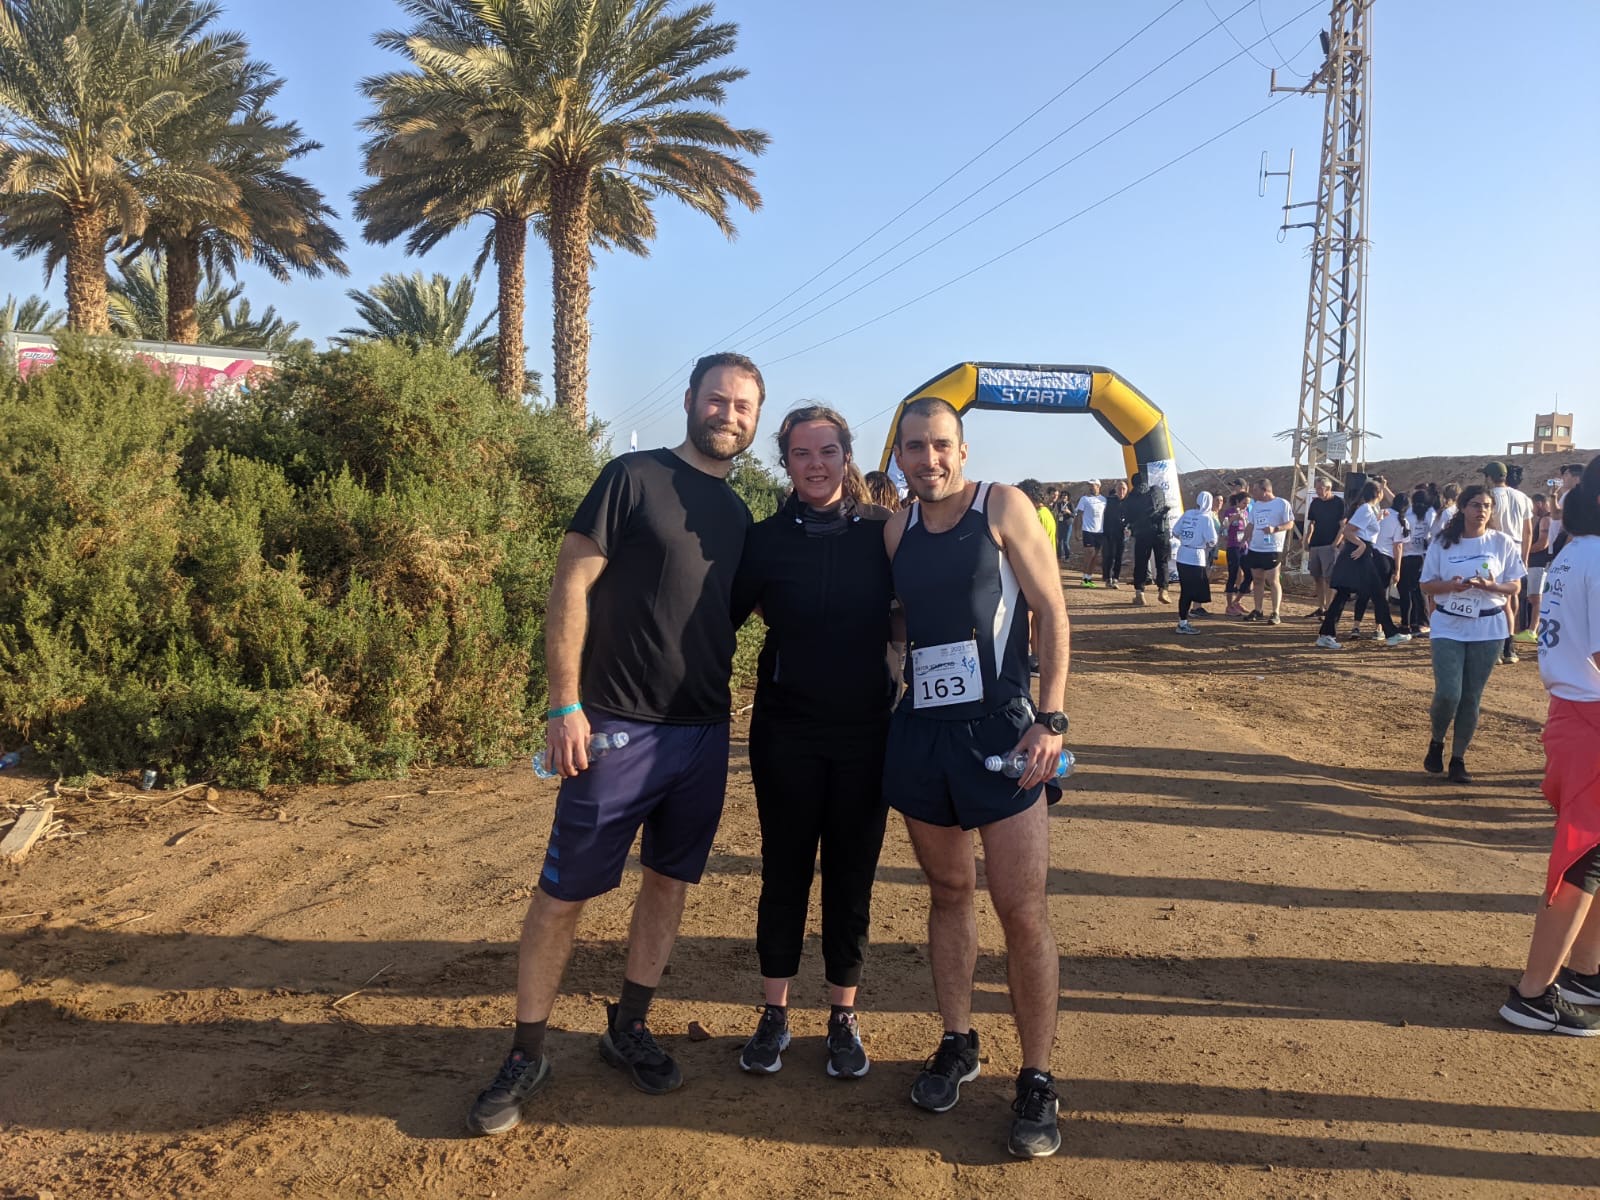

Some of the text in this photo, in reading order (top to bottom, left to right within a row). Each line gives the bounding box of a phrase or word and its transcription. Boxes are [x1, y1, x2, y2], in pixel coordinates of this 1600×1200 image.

[1001, 387, 1067, 404] START
[1450, 601, 1473, 614] 046
[921, 676, 966, 700] 163
